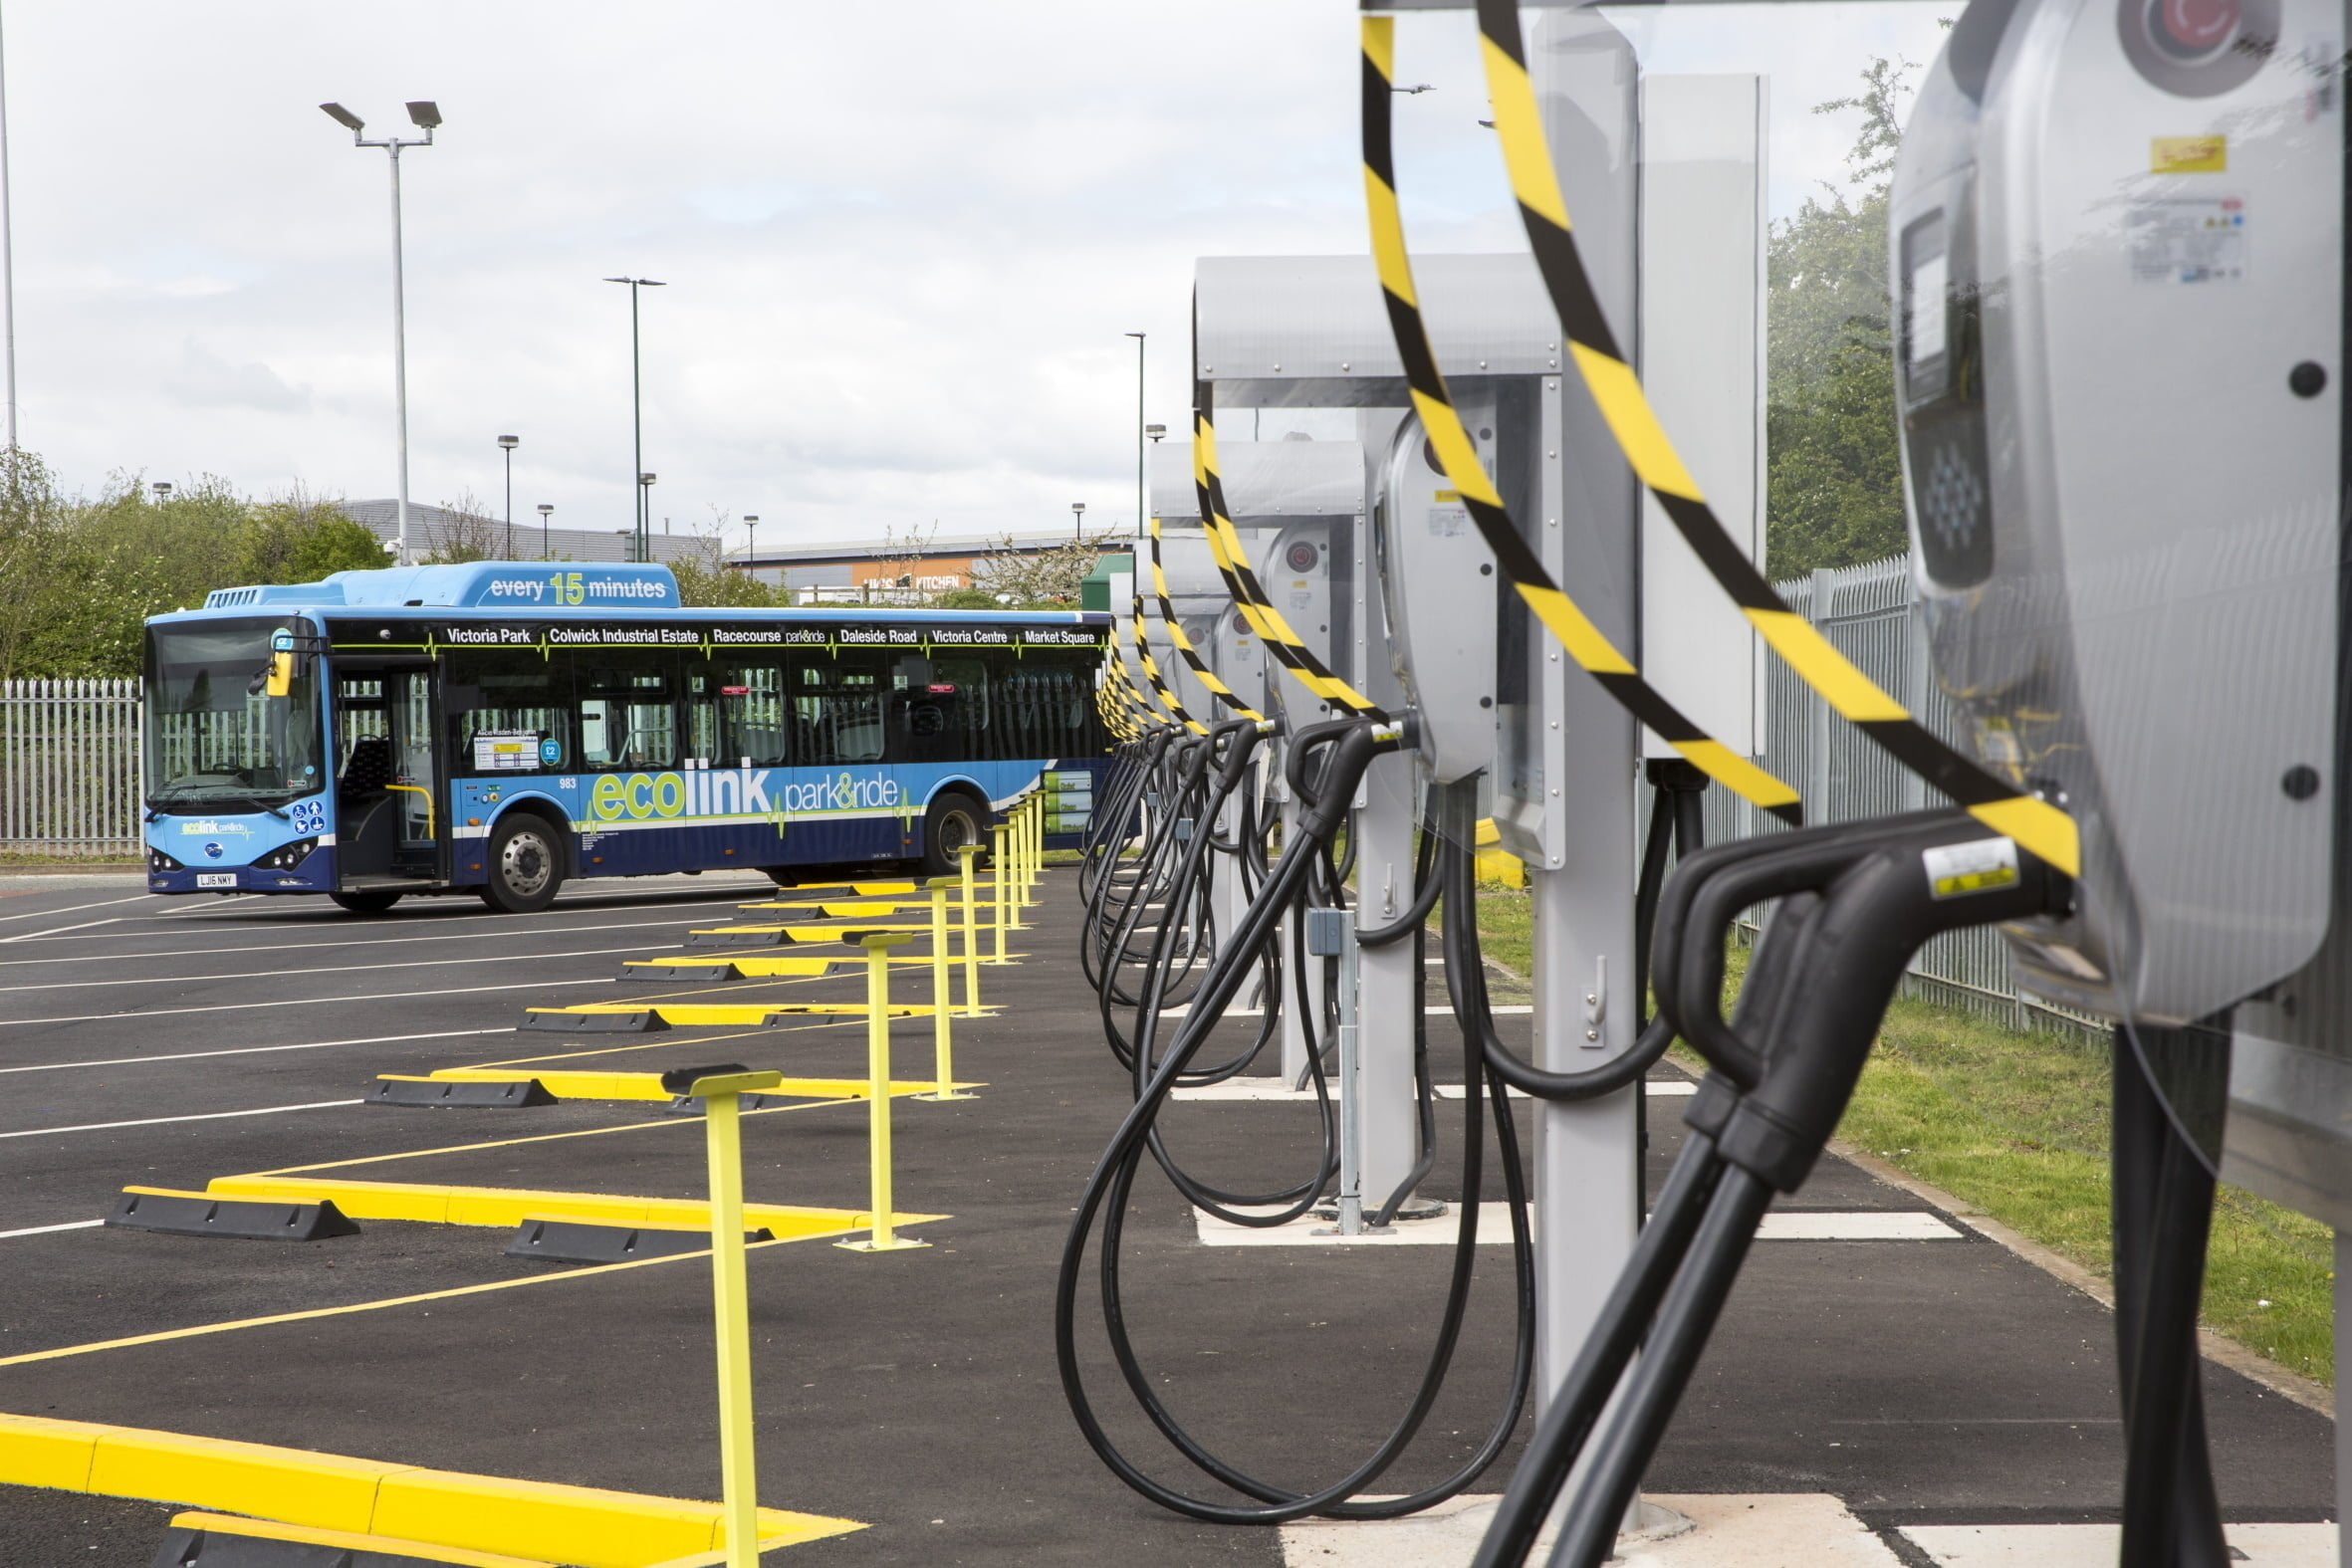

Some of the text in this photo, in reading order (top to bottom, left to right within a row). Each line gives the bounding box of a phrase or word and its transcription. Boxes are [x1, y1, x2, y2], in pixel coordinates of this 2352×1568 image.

[491, 572, 666, 605] every 15 minutes
[447, 628, 531, 643] Victoria Park
[550, 628, 699, 643] Colwick Industrial Estate
[713, 628, 825, 644] Racecourse park&ride
[840, 629, 917, 643] Daleside Road
[932, 629, 1008, 643] Victoria Centre
[1025, 630, 1095, 645] Market Square
[546, 746, 556, 756] £2
[559, 778, 577, 789] 983
[592, 757, 898, 820] ecolink park&ride
[182, 820, 219, 834] ecolink
[217, 875, 232, 885] NMY
